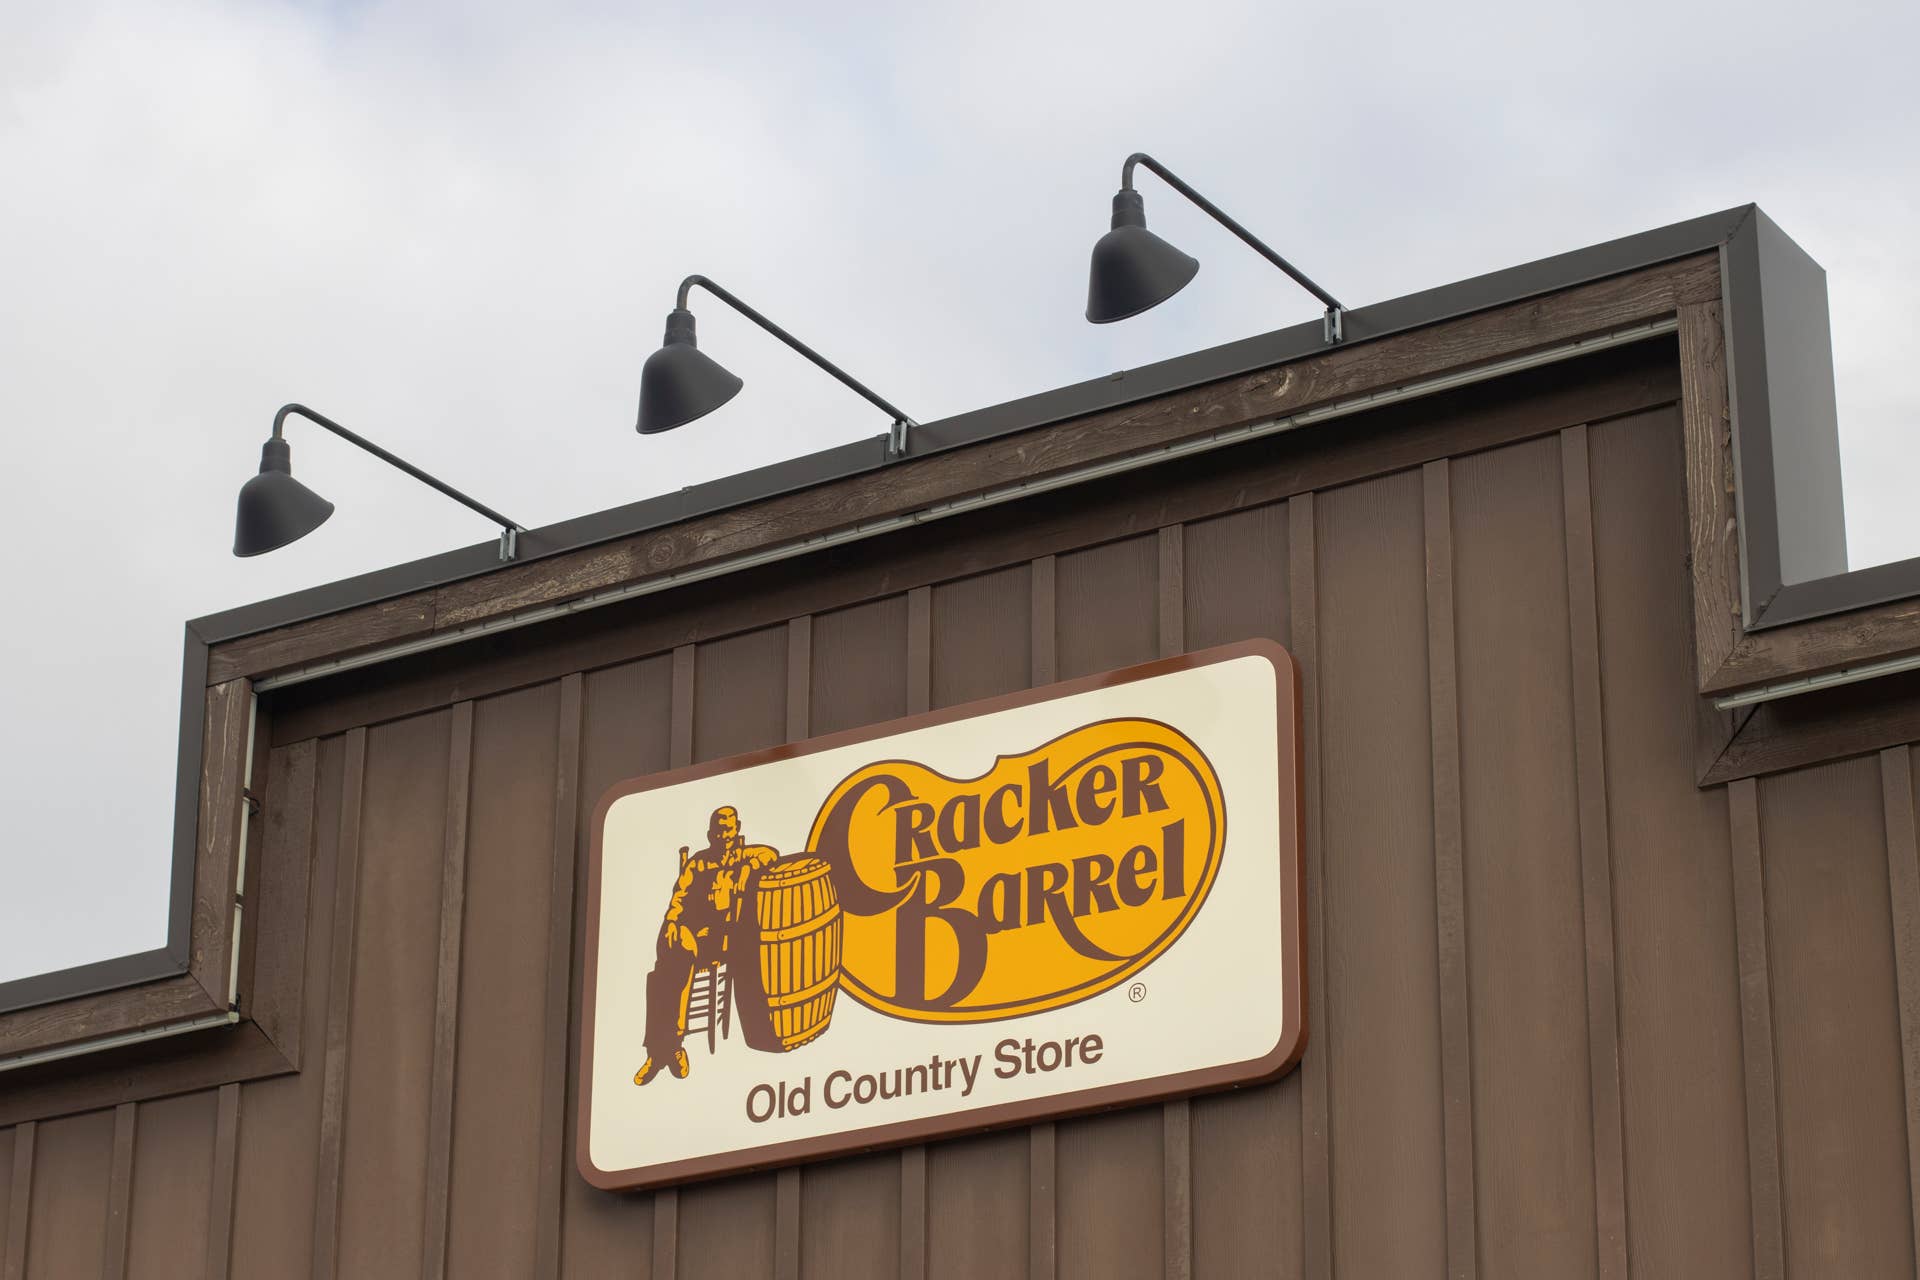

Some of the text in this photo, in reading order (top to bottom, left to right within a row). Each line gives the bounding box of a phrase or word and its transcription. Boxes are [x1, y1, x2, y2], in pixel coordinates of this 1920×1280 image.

[745, 1033, 1104, 1124] Old Country Store
